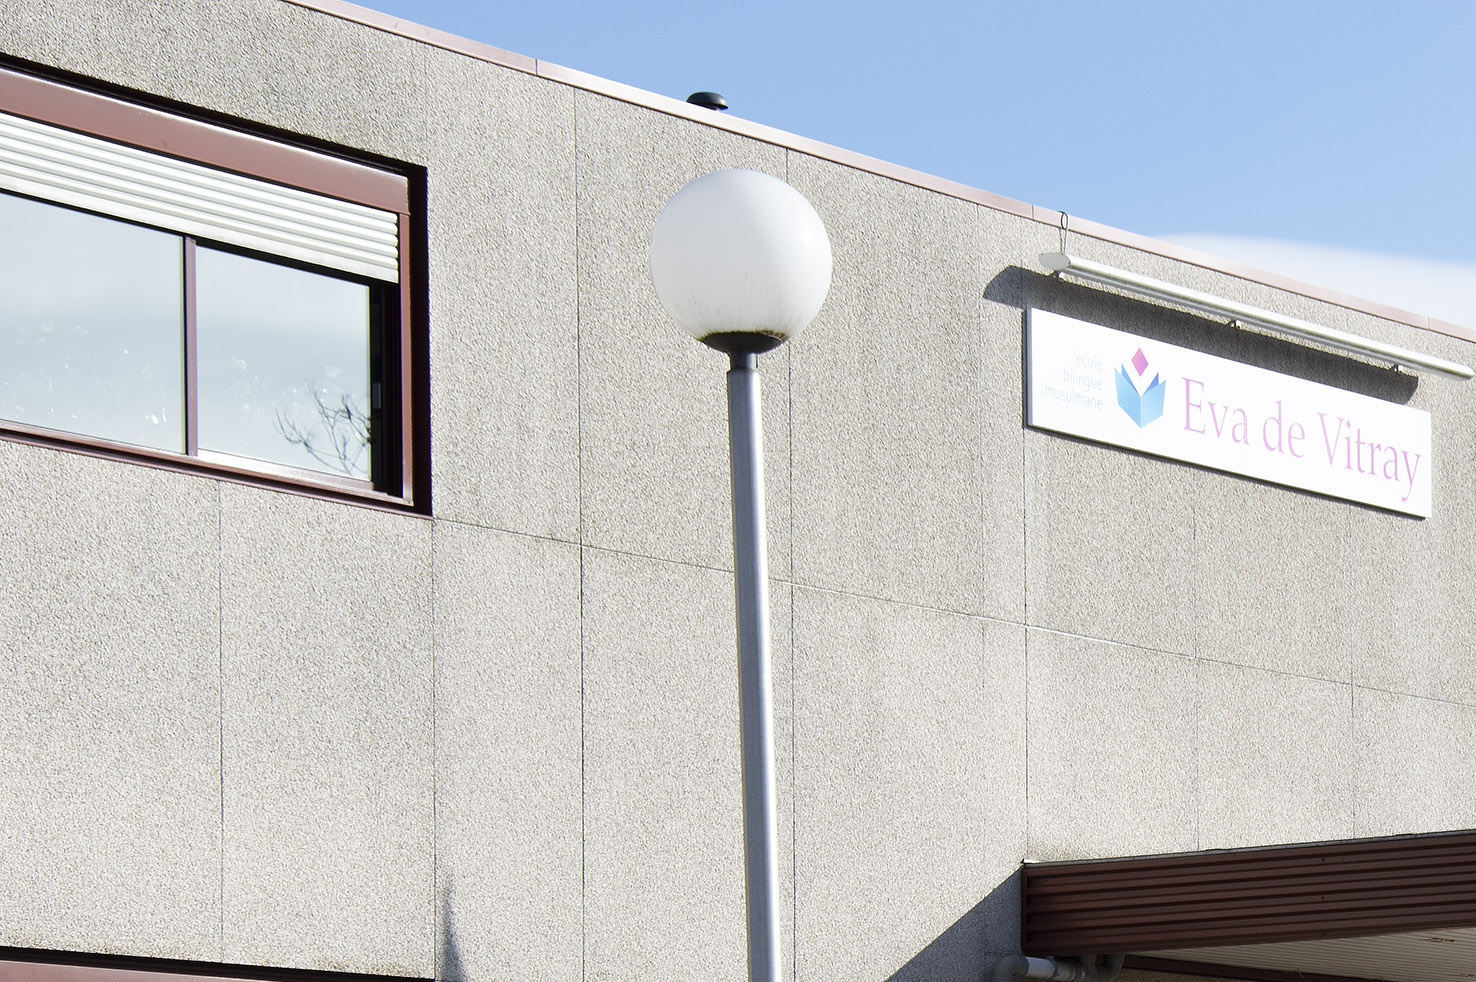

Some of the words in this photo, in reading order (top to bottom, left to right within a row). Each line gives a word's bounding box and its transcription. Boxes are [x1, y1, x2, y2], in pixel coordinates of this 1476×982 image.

[1063, 365, 1103, 392] bilingue
[1044, 385, 1103, 410] musulmane
[1182, 376, 1250, 446] Eva
[1262, 400, 1306, 458] de
[1317, 412, 1421, 502] Vitray
